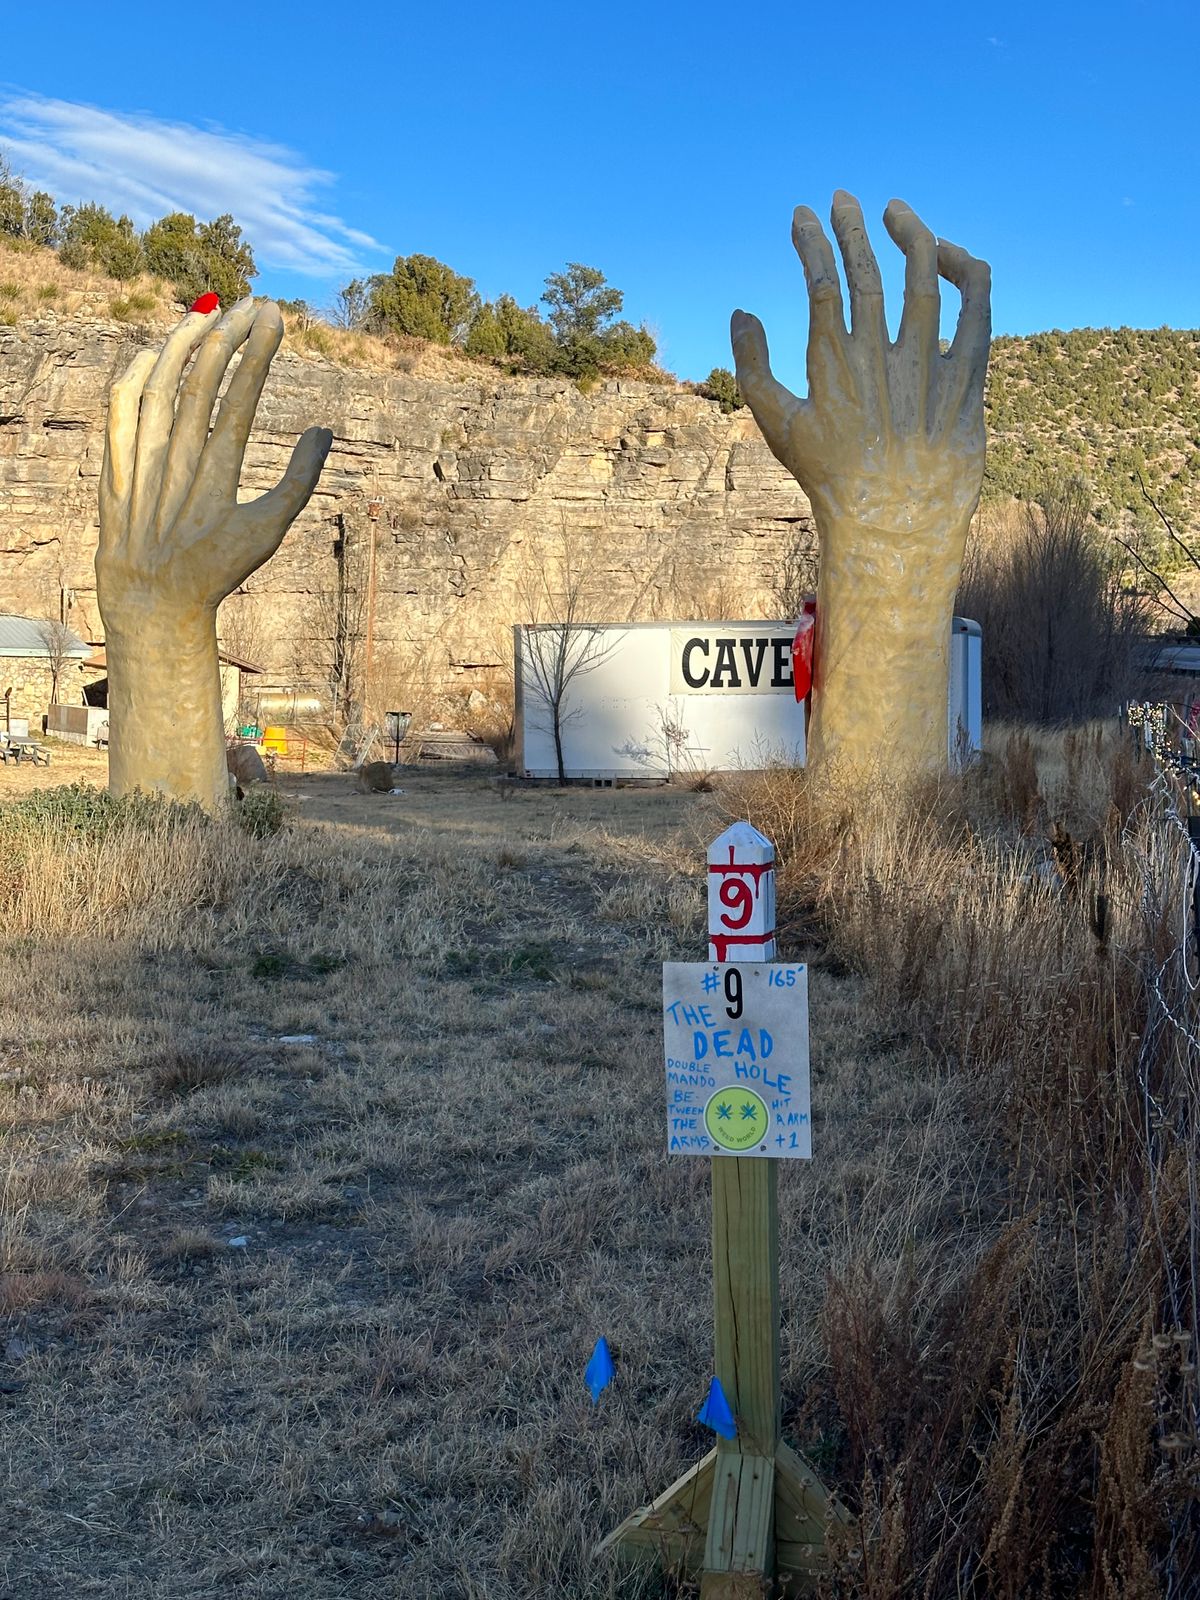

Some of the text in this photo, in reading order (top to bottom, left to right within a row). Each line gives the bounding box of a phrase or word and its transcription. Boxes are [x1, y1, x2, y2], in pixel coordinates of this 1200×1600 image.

[682, 638, 795, 688] CAVE
[720, 878, 753, 930] 9
[667, 1001, 717, 1028] THE
[693, 1028, 774, 1062] DEAD
[667, 1058, 711, 1074] DOUBLE
[667, 1071, 716, 1088] MANDO
[734, 1061, 792, 1096] HOLE
[772, 1097, 792, 1110] HIT
[671, 1118, 698, 1131] THE
[776, 1112, 809, 1126] A ARM
[670, 1135, 710, 1151] ARMS
